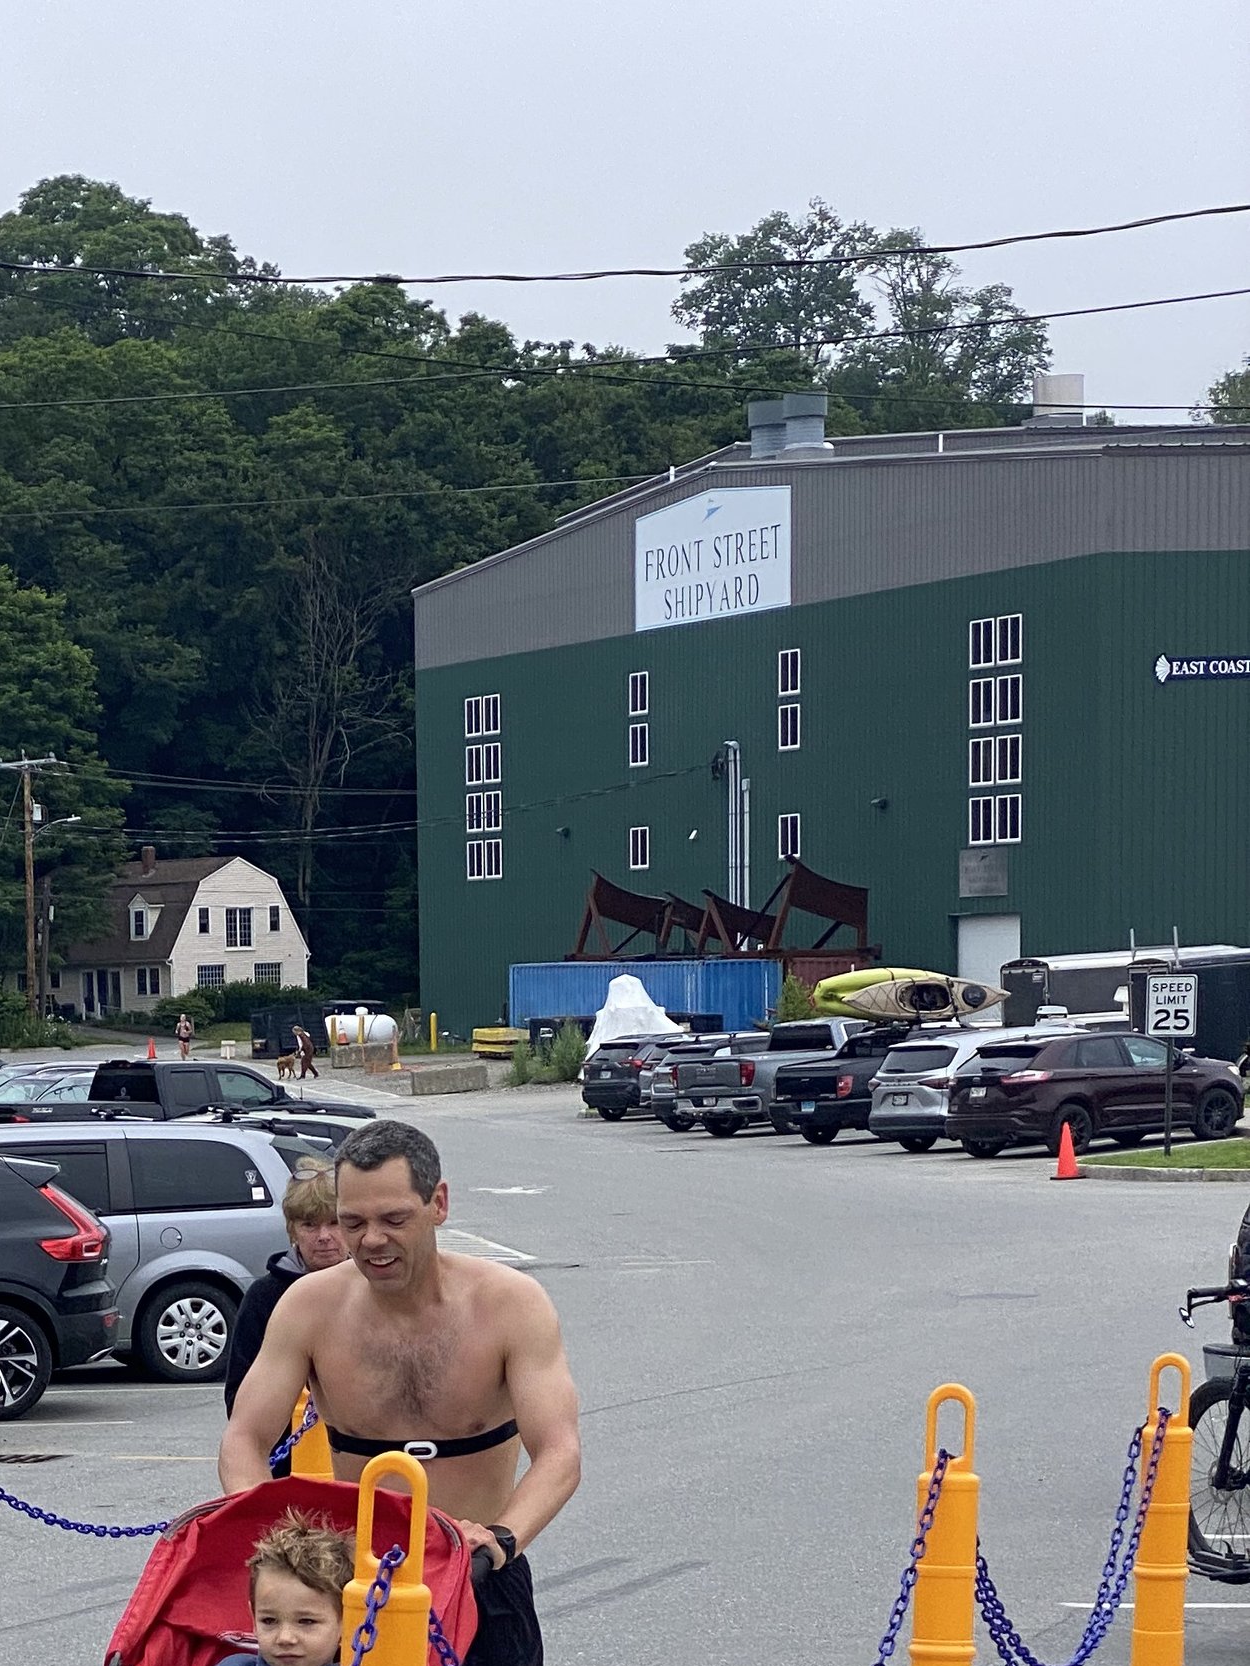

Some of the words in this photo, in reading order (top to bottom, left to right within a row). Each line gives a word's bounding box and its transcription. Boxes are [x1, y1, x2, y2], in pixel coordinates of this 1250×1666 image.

[645, 539, 703, 582] FRONT
[713, 524, 781, 569] STREET
[664, 573, 760, 620] SHIPYARD
[1172, 660, 1207, 675] EAST
[1209, 659, 1250, 674] COAST
[1152, 982, 1193, 992] SPEED
[1155, 995, 1187, 1005] LIMIT
[1153, 1009, 1190, 1031] 25
